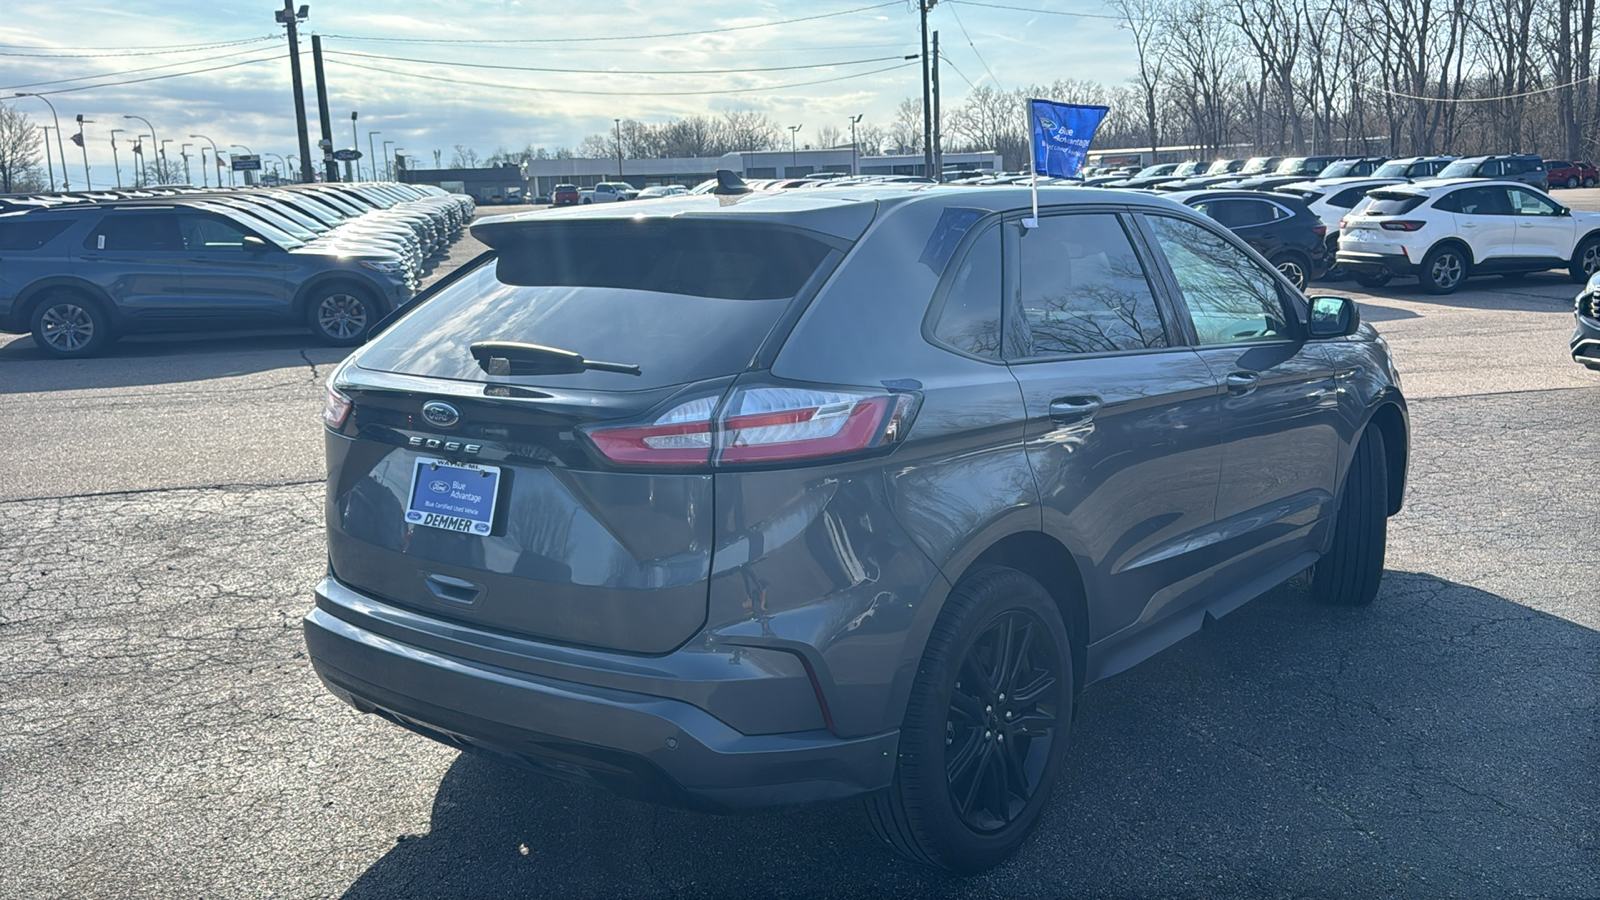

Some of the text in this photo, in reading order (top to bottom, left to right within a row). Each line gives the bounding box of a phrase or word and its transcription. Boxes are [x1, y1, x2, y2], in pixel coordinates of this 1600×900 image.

[337, 151, 357, 160] Ford
[428, 406, 450, 422] Ford
[408, 436, 482, 454] EDGE
[431, 481, 448, 492] Ford
[452, 480, 467, 490] Blue
[449, 490, 482, 504] Advantage
[424, 500, 479, 516] Blue Certified Used Vehicle
[408, 512, 421, 520] Ford
[423, 513, 472, 532] DEMMER
[476, 524, 489, 532] Ford
